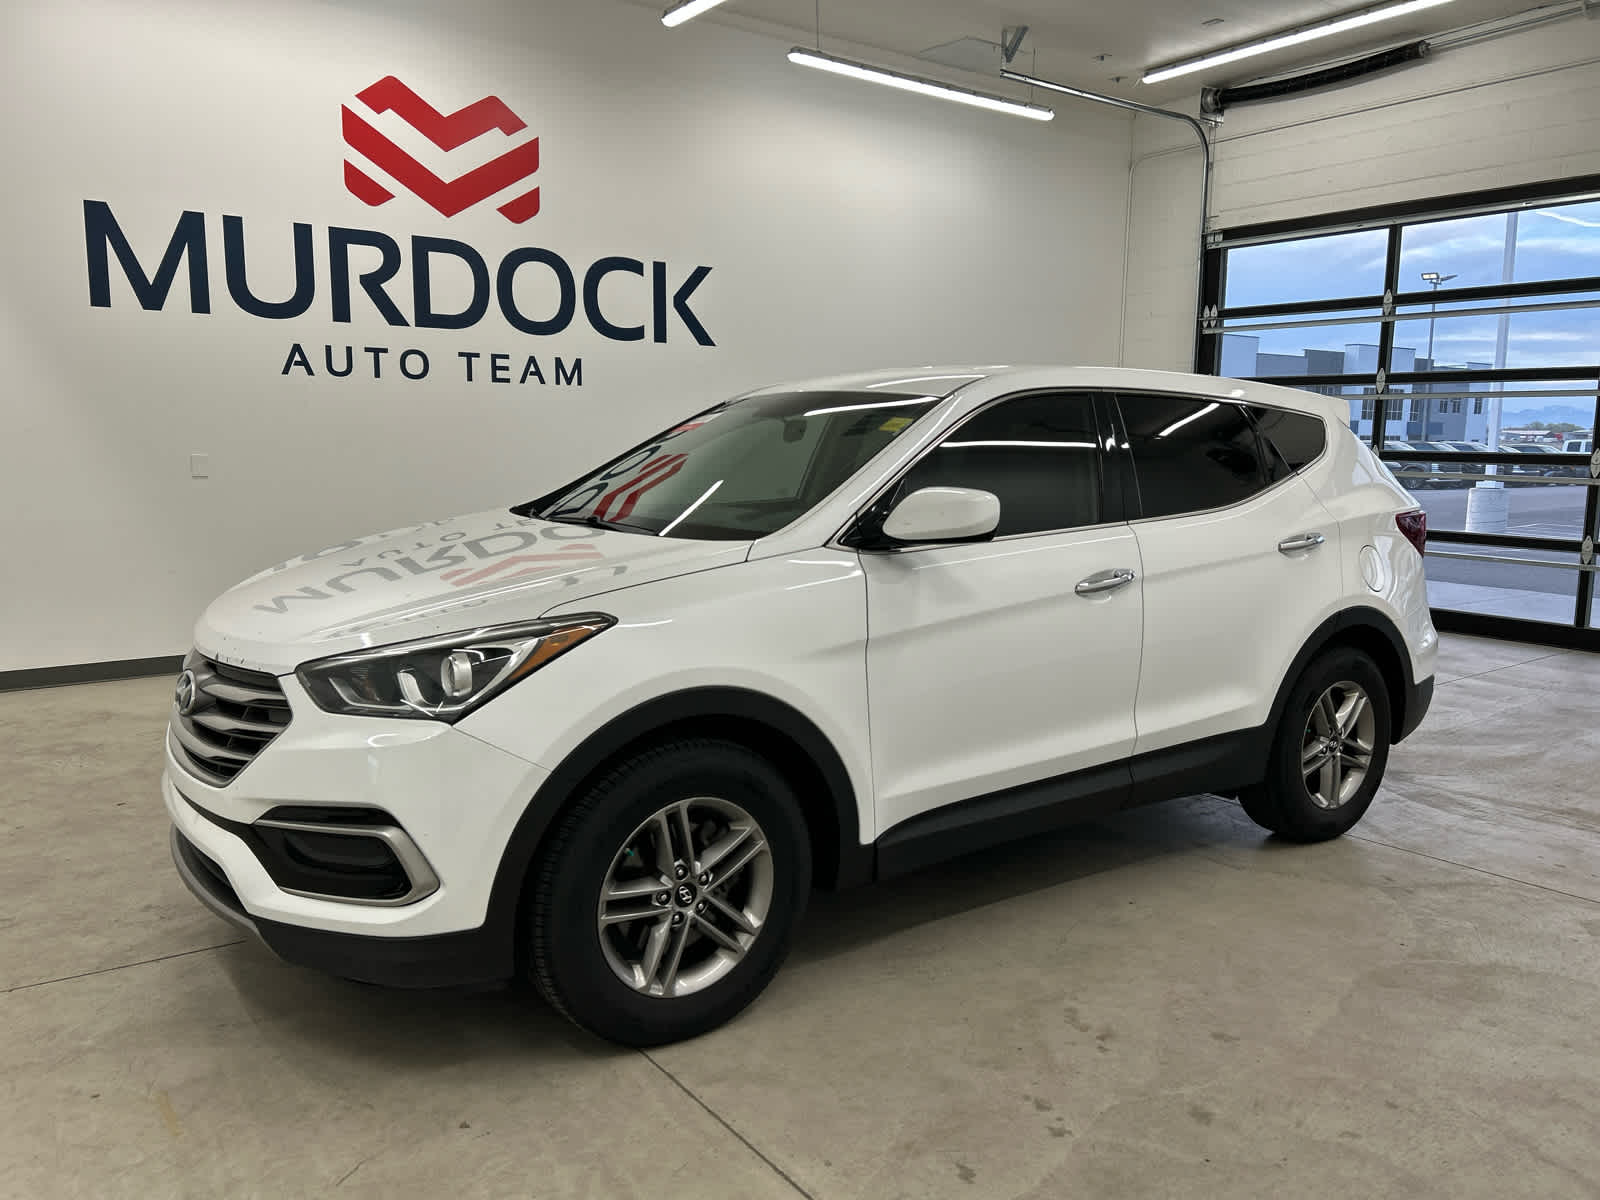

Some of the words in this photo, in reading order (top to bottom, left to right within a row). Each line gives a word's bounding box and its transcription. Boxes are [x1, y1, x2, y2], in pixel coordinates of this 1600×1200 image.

[83, 199, 717, 347] MURDOCK
[282, 343, 430, 380] AUTO
[457, 351, 584, 387] TEAM
